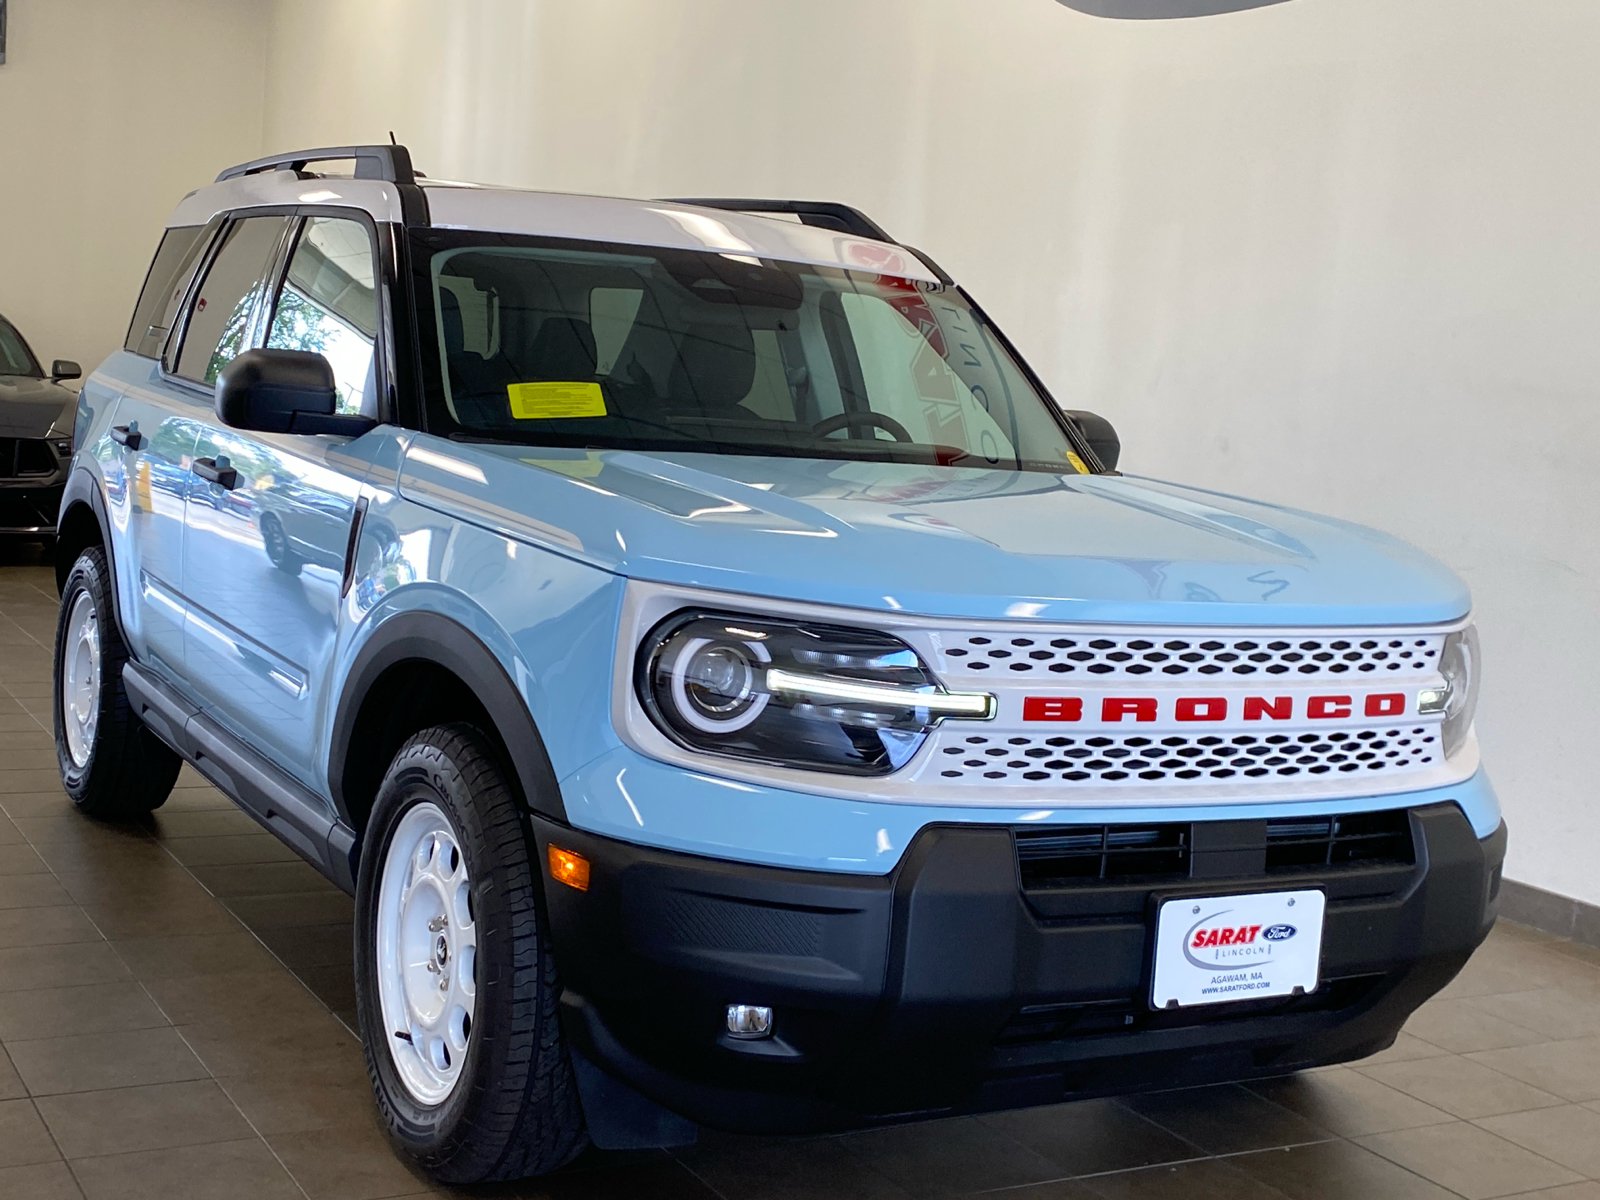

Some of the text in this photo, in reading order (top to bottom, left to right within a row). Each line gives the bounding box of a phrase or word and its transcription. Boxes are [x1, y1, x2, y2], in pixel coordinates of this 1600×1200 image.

[1022, 693, 1405, 722] BRONCO
[1191, 925, 1293, 947] SARAT Ford
[1222, 947, 1265, 957] LINCOLN
[1211, 971, 1263, 984] AGAWAM, MA
[1202, 982, 1270, 994] WWW.SARATFORD.COM
